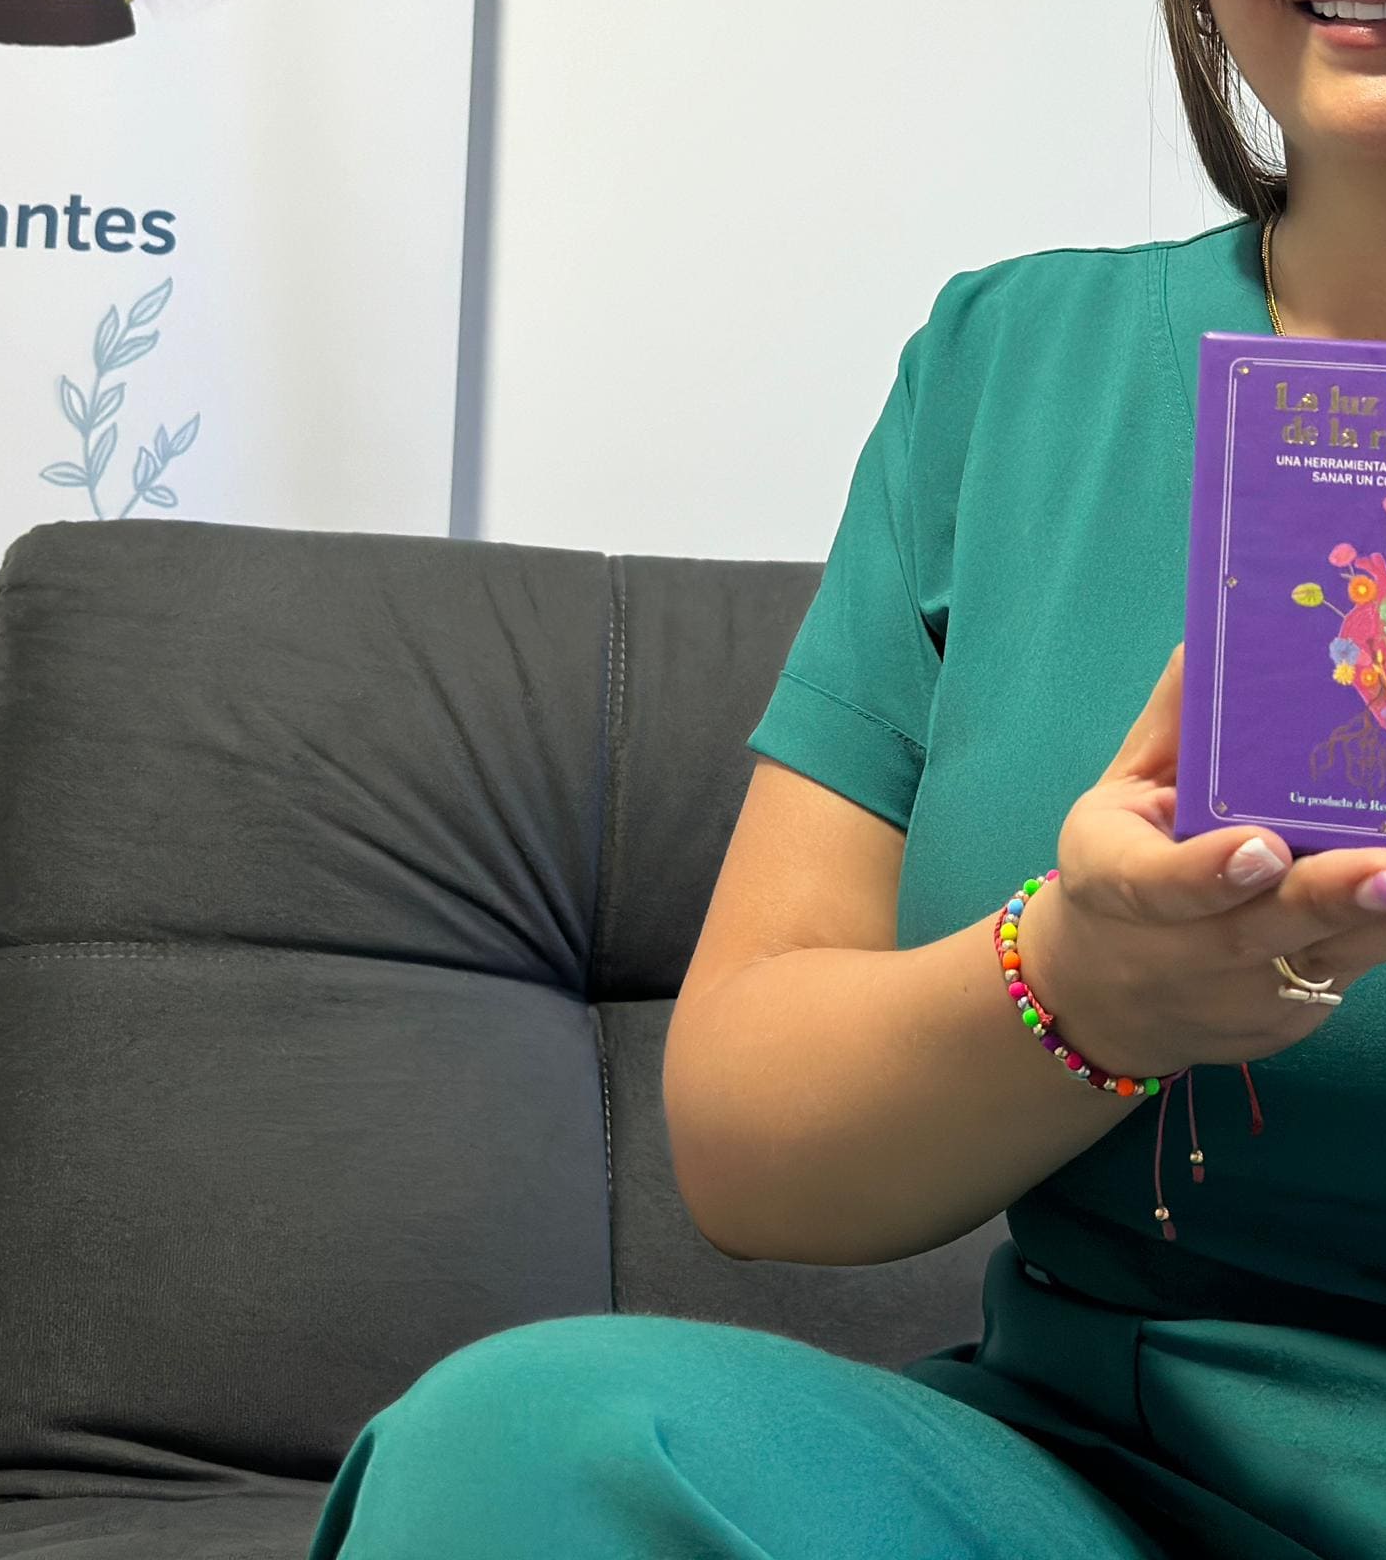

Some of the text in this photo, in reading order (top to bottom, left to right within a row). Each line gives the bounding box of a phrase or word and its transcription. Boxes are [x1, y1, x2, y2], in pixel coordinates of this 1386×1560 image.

[1275, 382, 1319, 412] La
[1328, 385, 1379, 415] luz
[1282, 416, 1319, 445] de
[1328, 417, 1359, 448] la
[1276, 455, 1301, 468] UNA
[1312, 471, 1353, 485] SANAR
[1356, 474, 1373, 487] UN
[1290, 792, 1306, 804] Un
[1308, 795, 1353, 808] producto
[1355, 798, 1368, 810] de
